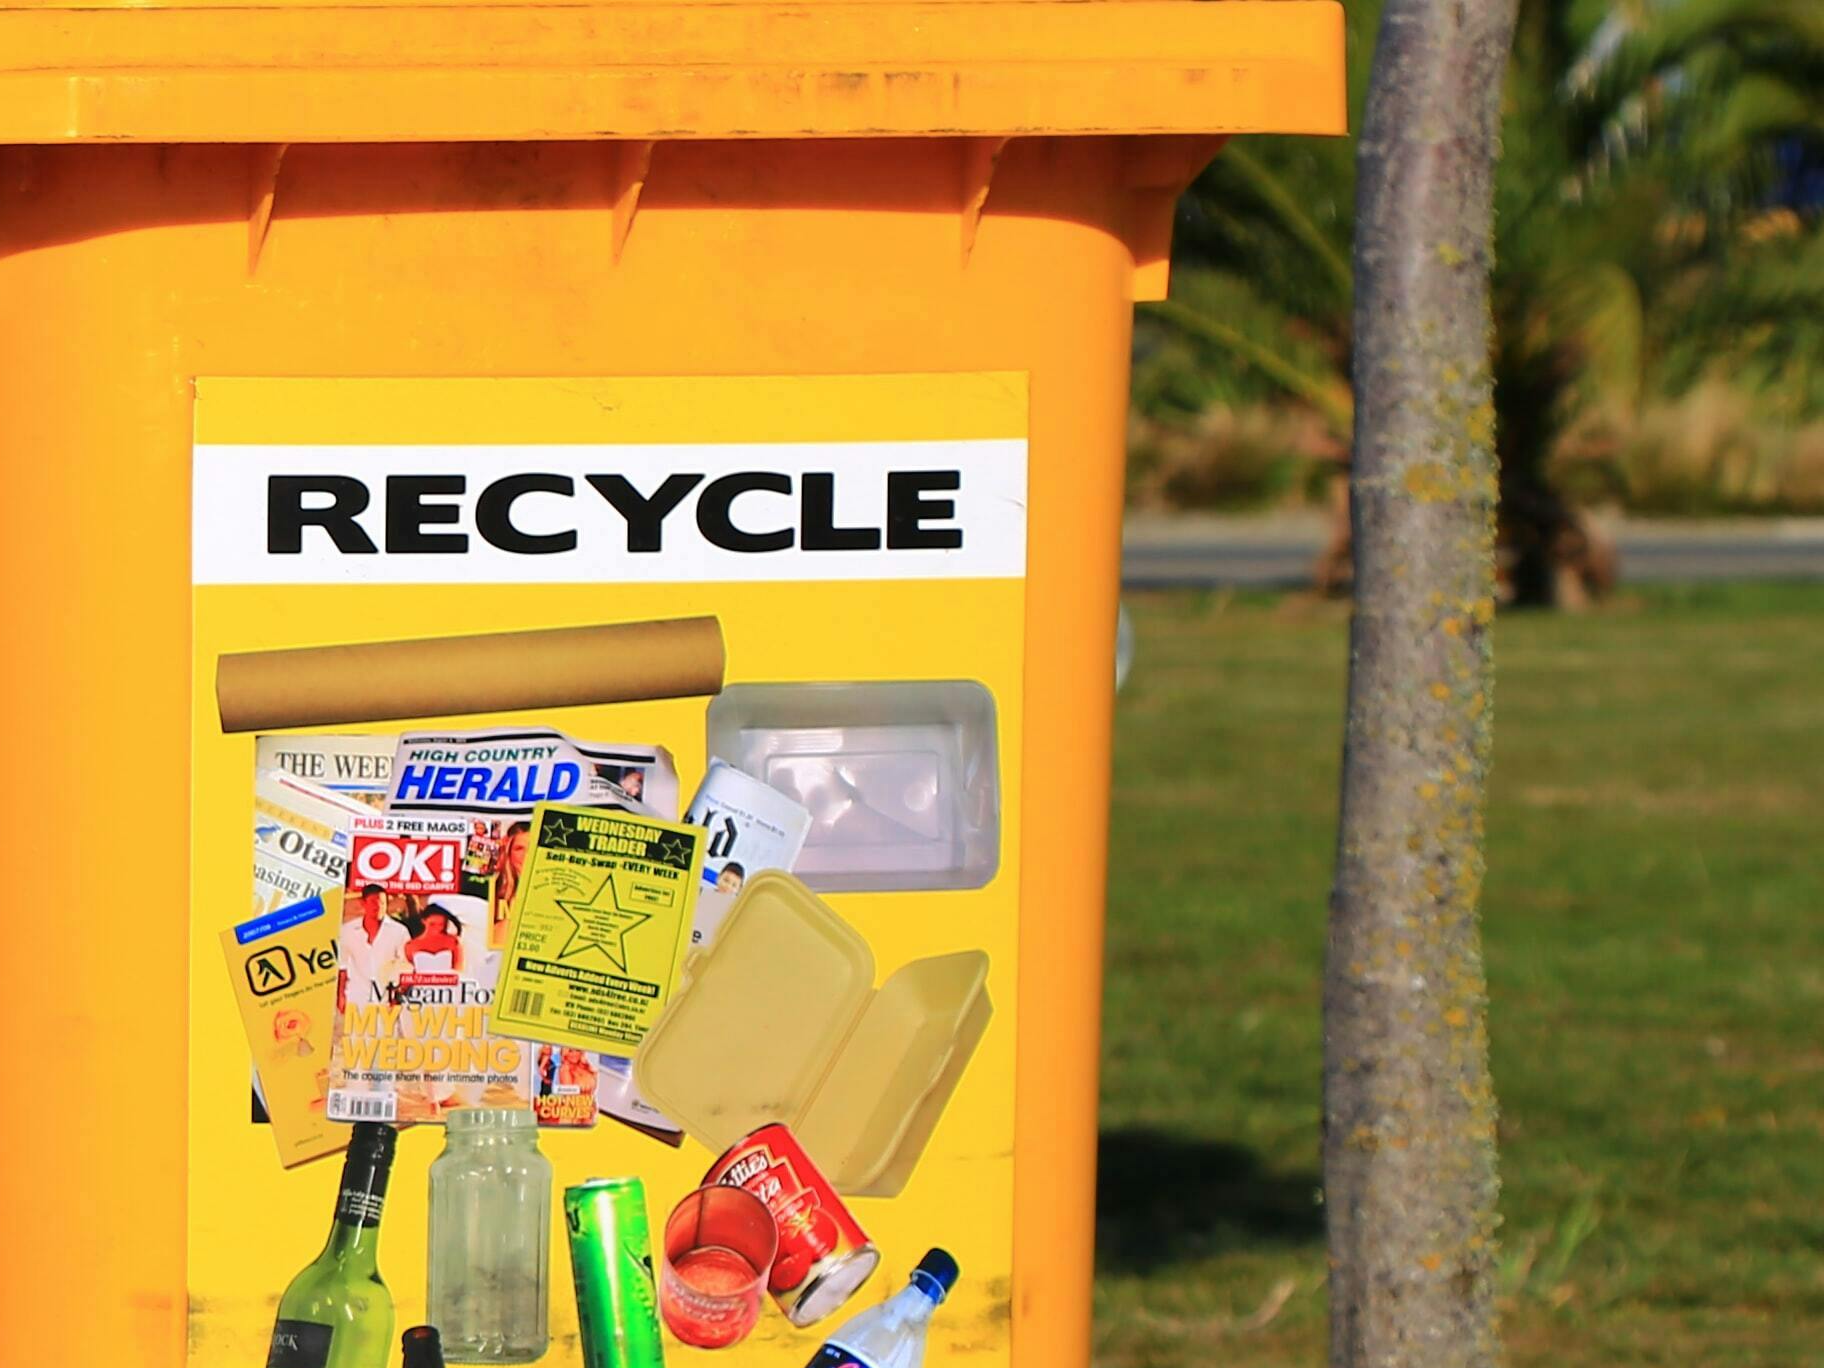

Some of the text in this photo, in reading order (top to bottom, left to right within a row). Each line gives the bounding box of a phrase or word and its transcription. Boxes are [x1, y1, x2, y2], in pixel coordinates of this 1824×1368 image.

[266, 470, 963, 555] RECYCLE
[274, 751, 326, 778] THE
[409, 745, 558, 763] HIGH COUNTRY
[396, 761, 581, 803] HERALD
[354, 816, 466, 833] PLUS 2 FREE MAGS
[576, 815, 663, 844] WEDNESDAY
[279, 830, 347, 878] Otag
[588, 833, 647, 857] TRADER
[356, 840, 455, 883] OK!
[653, 867, 679, 880] WEEK
[518, 931, 547, 944] PRICE
[525, 960, 656, 996] New Adverts Added Every Week!
[343, 1003, 494, 1040] MY WHI
[341, 1036, 522, 1073] WEDDING
[343, 1070, 519, 1085] The couple share their intimate photos
[540, 1106, 590, 1119] CURVES
